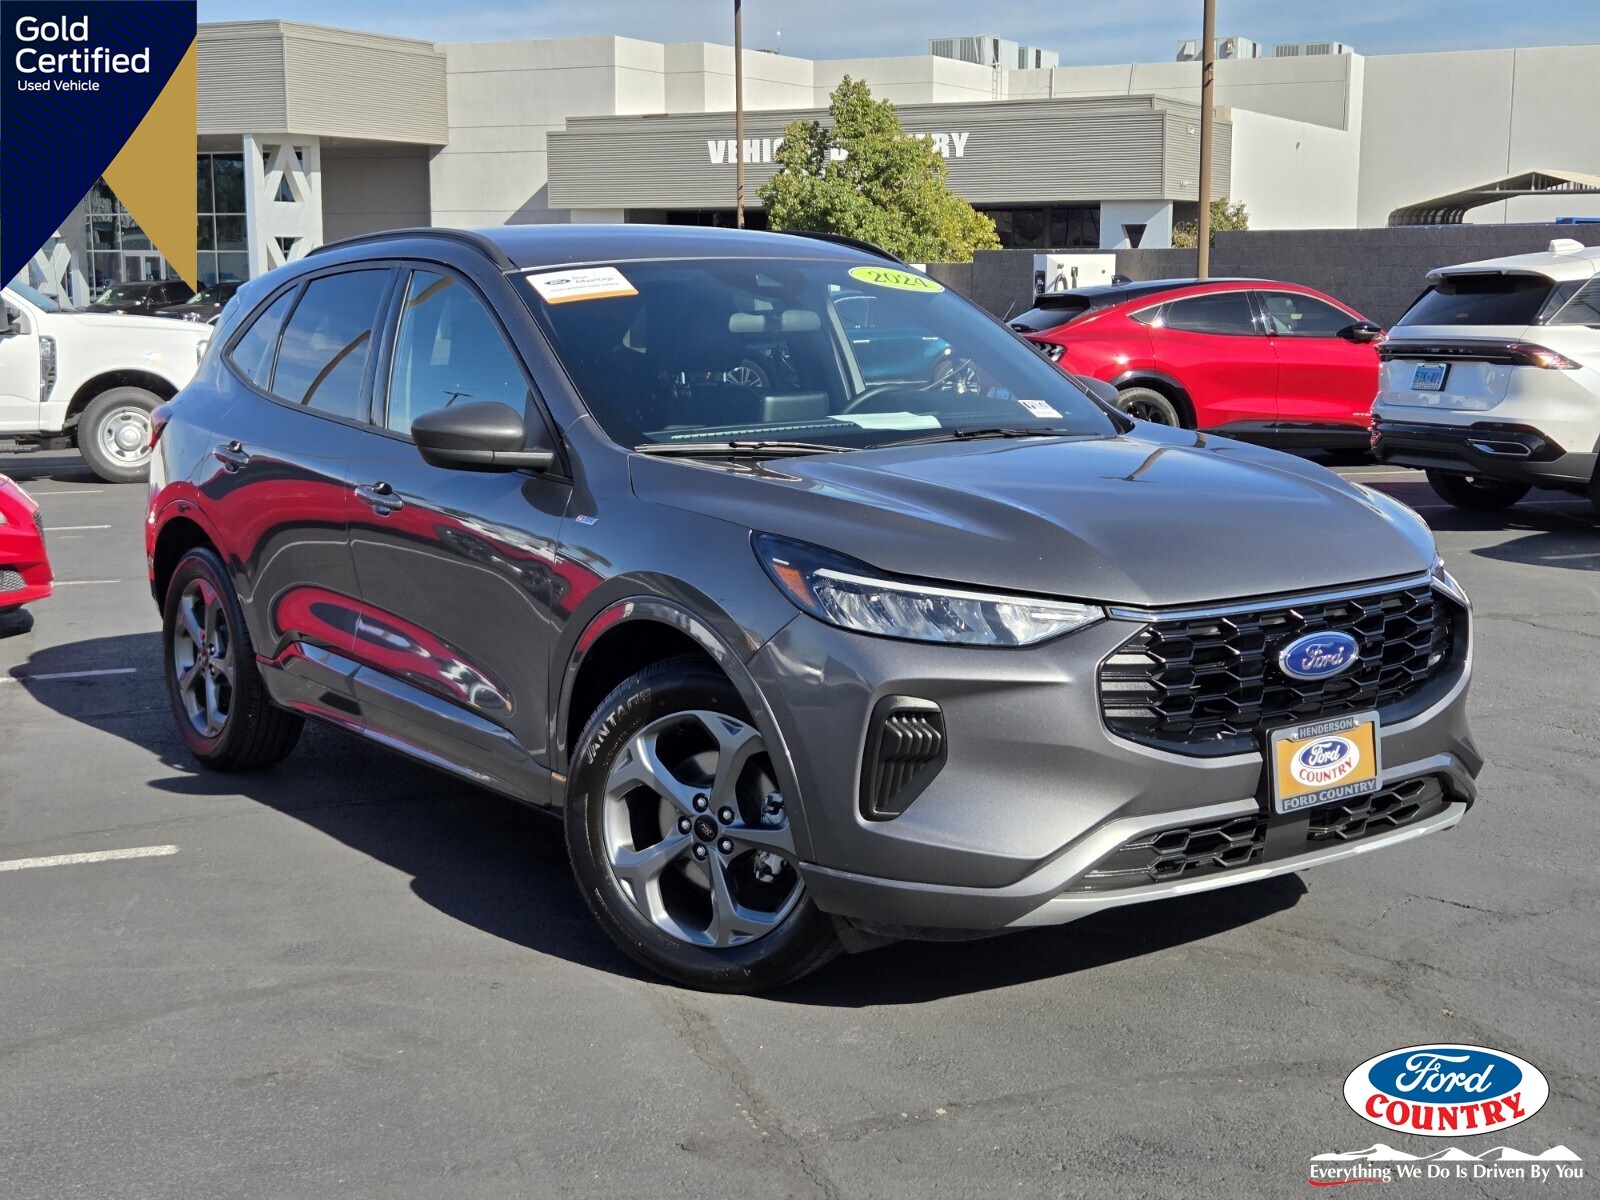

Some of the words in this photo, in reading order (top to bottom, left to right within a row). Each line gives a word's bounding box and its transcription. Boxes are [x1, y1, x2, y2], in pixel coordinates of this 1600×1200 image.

[868, 270, 930, 288] 2024
[1302, 643, 1345, 670] Ford
[1300, 718, 1353, 738] HENDERSON
[1308, 742, 1341, 766] Ford
[1300, 758, 1353, 783] COUNTRY
[1284, 793, 1318, 810] FORD
[1319, 779, 1376, 801] COUNTRY
